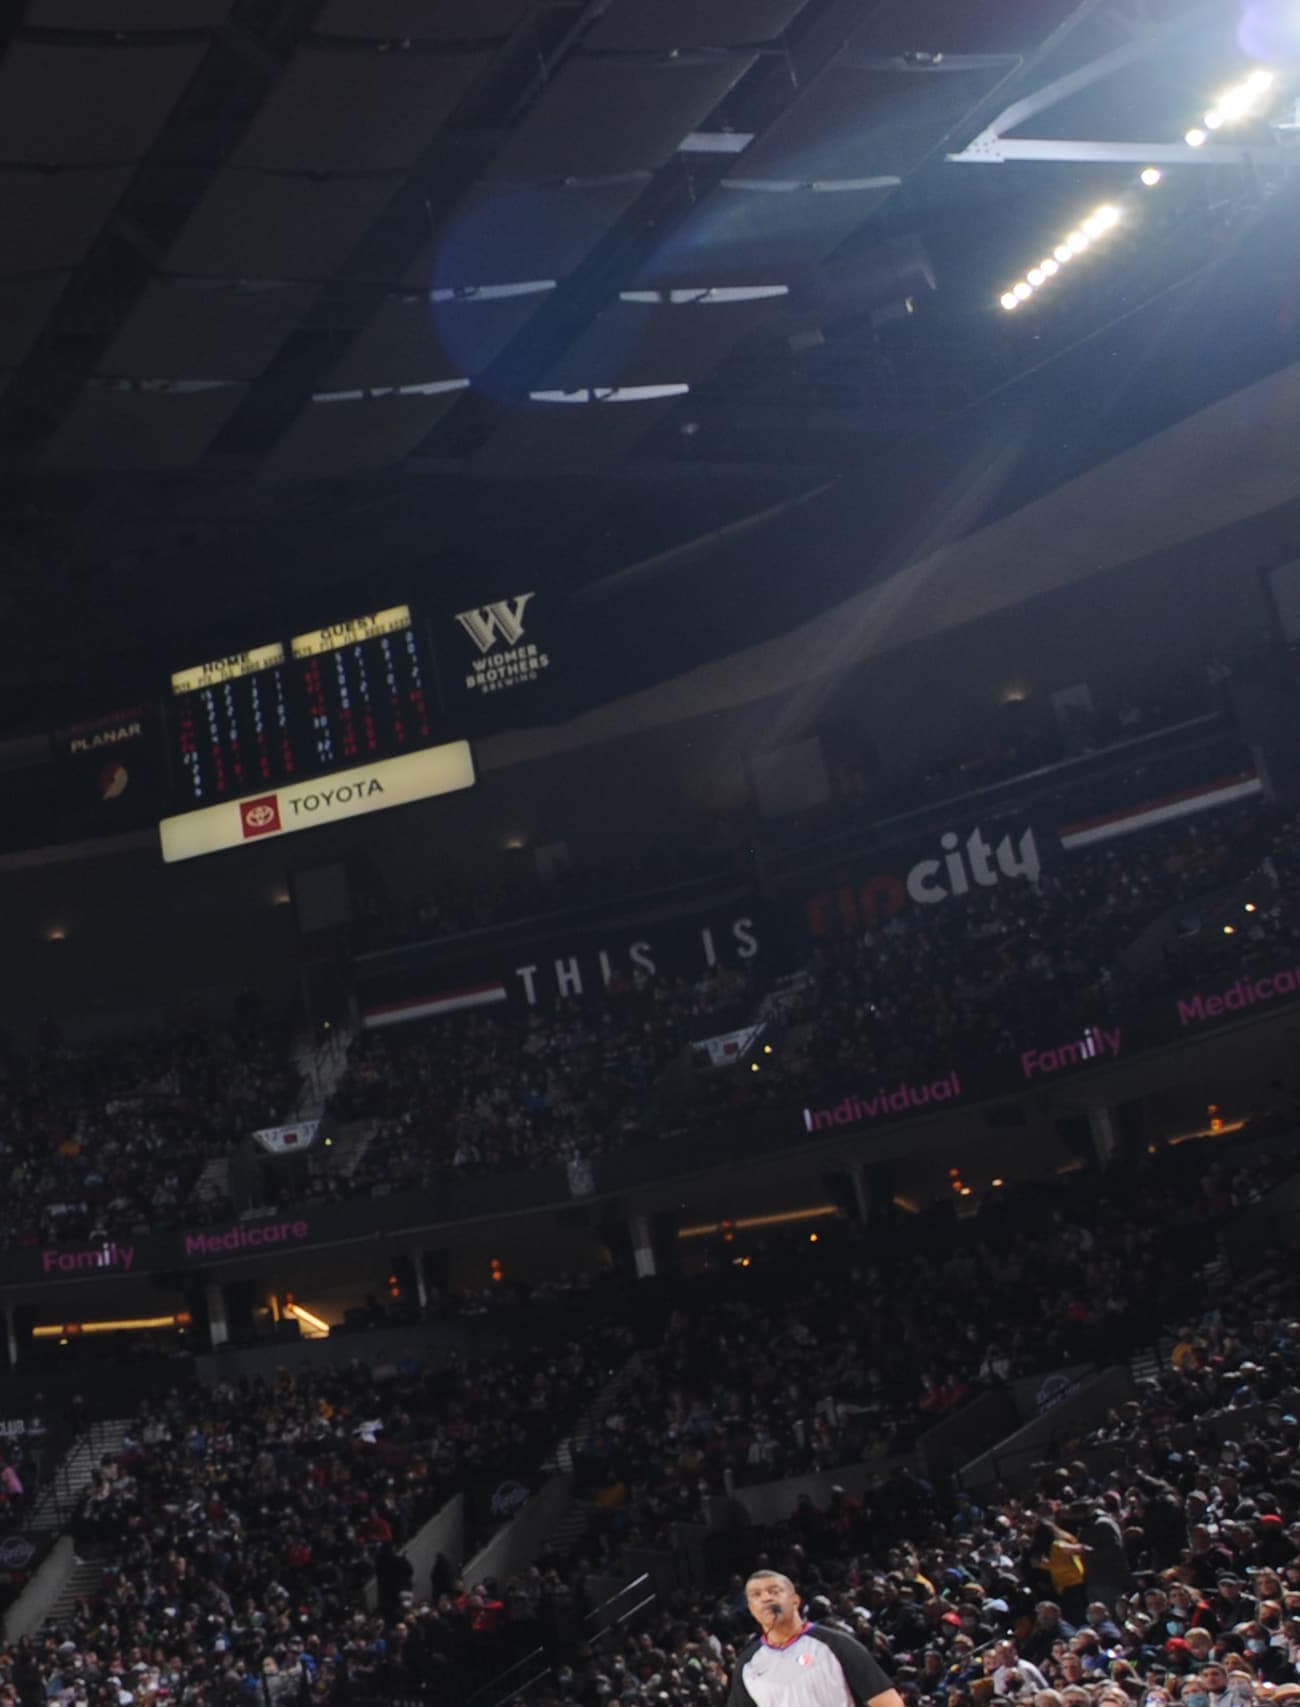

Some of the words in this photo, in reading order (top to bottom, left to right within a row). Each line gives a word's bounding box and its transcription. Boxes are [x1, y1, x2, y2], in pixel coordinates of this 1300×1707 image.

[465, 653, 550, 689] BROTHERS
[472, 643, 538, 672] WIDMER
[70, 722, 142, 754] PLANAR
[288, 776, 384, 818] TOYOTA
[516, 941, 656, 1005] THIS
[702, 917, 759, 967] IS
[802, 1070, 962, 1132] Individual
[1019, 1026, 1123, 1080] Family
[1175, 971, 1300, 1027] Medica
[42, 1241, 136, 1274] Family
[184, 1220, 310, 1257] Medicare
